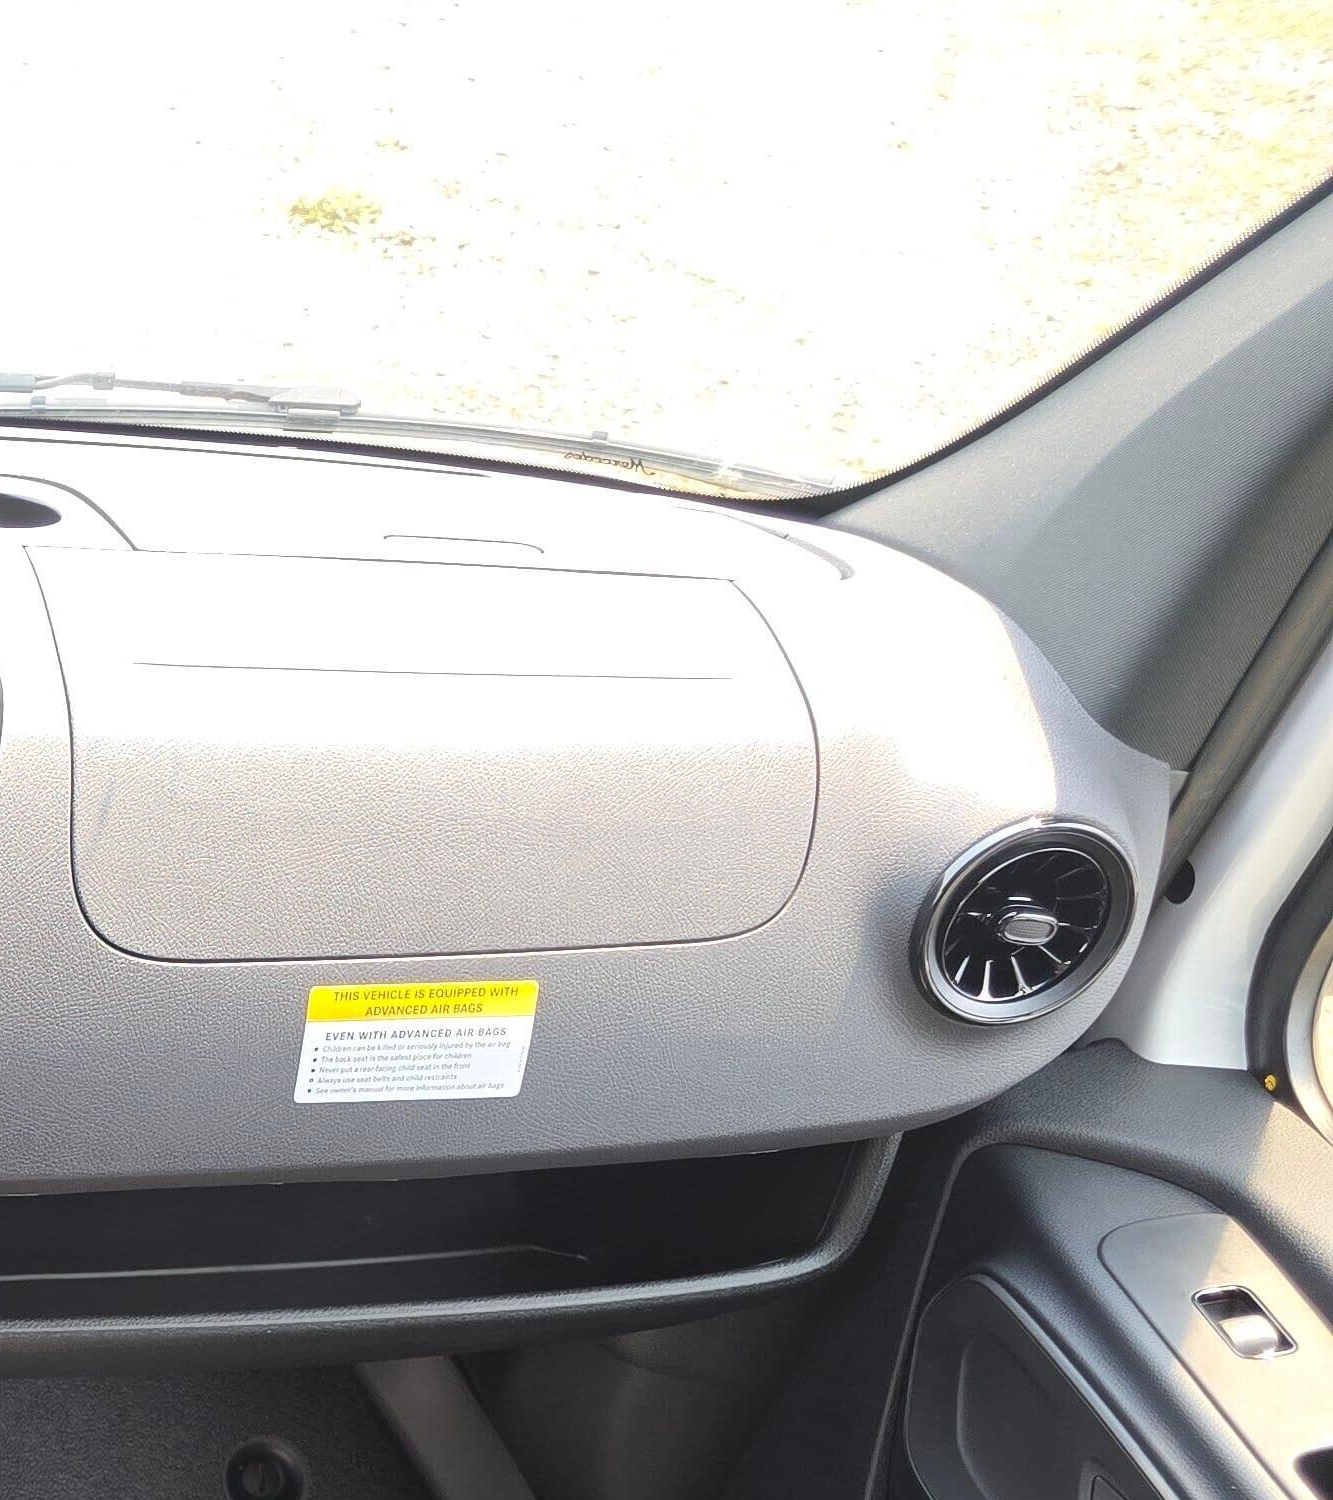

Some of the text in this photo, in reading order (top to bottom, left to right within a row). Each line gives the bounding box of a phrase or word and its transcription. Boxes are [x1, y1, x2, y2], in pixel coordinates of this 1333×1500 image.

[334, 986, 518, 1001] THIS VEHICLE IS EQUIPPED WITH
[365, 1003, 483, 1016] ADVANCED AIR BAGS
[325, 1027, 507, 1041] EVEN WITH ADVANCED AIR BAGS
